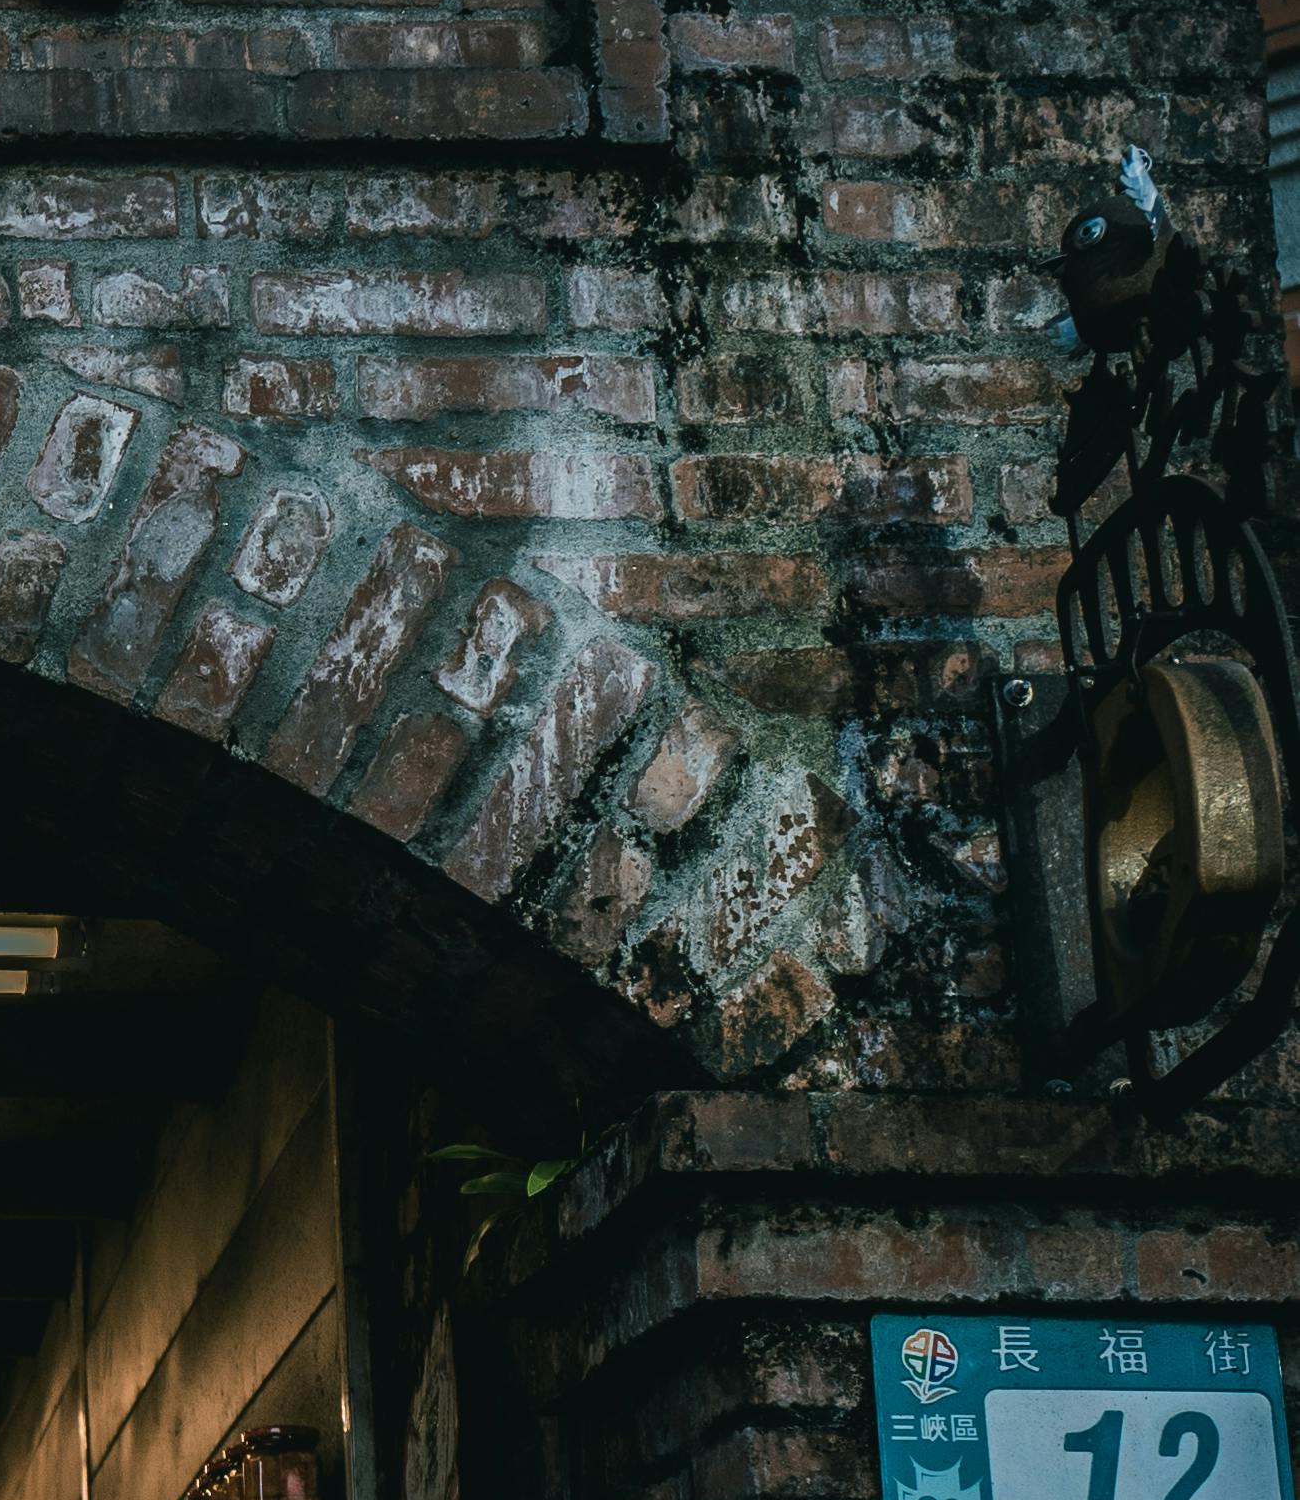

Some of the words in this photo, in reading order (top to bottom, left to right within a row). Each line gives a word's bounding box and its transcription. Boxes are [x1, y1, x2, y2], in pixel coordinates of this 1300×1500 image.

[991, 1325, 1251, 1376] 長福街
[890, 1413, 980, 1443] 三峽區
